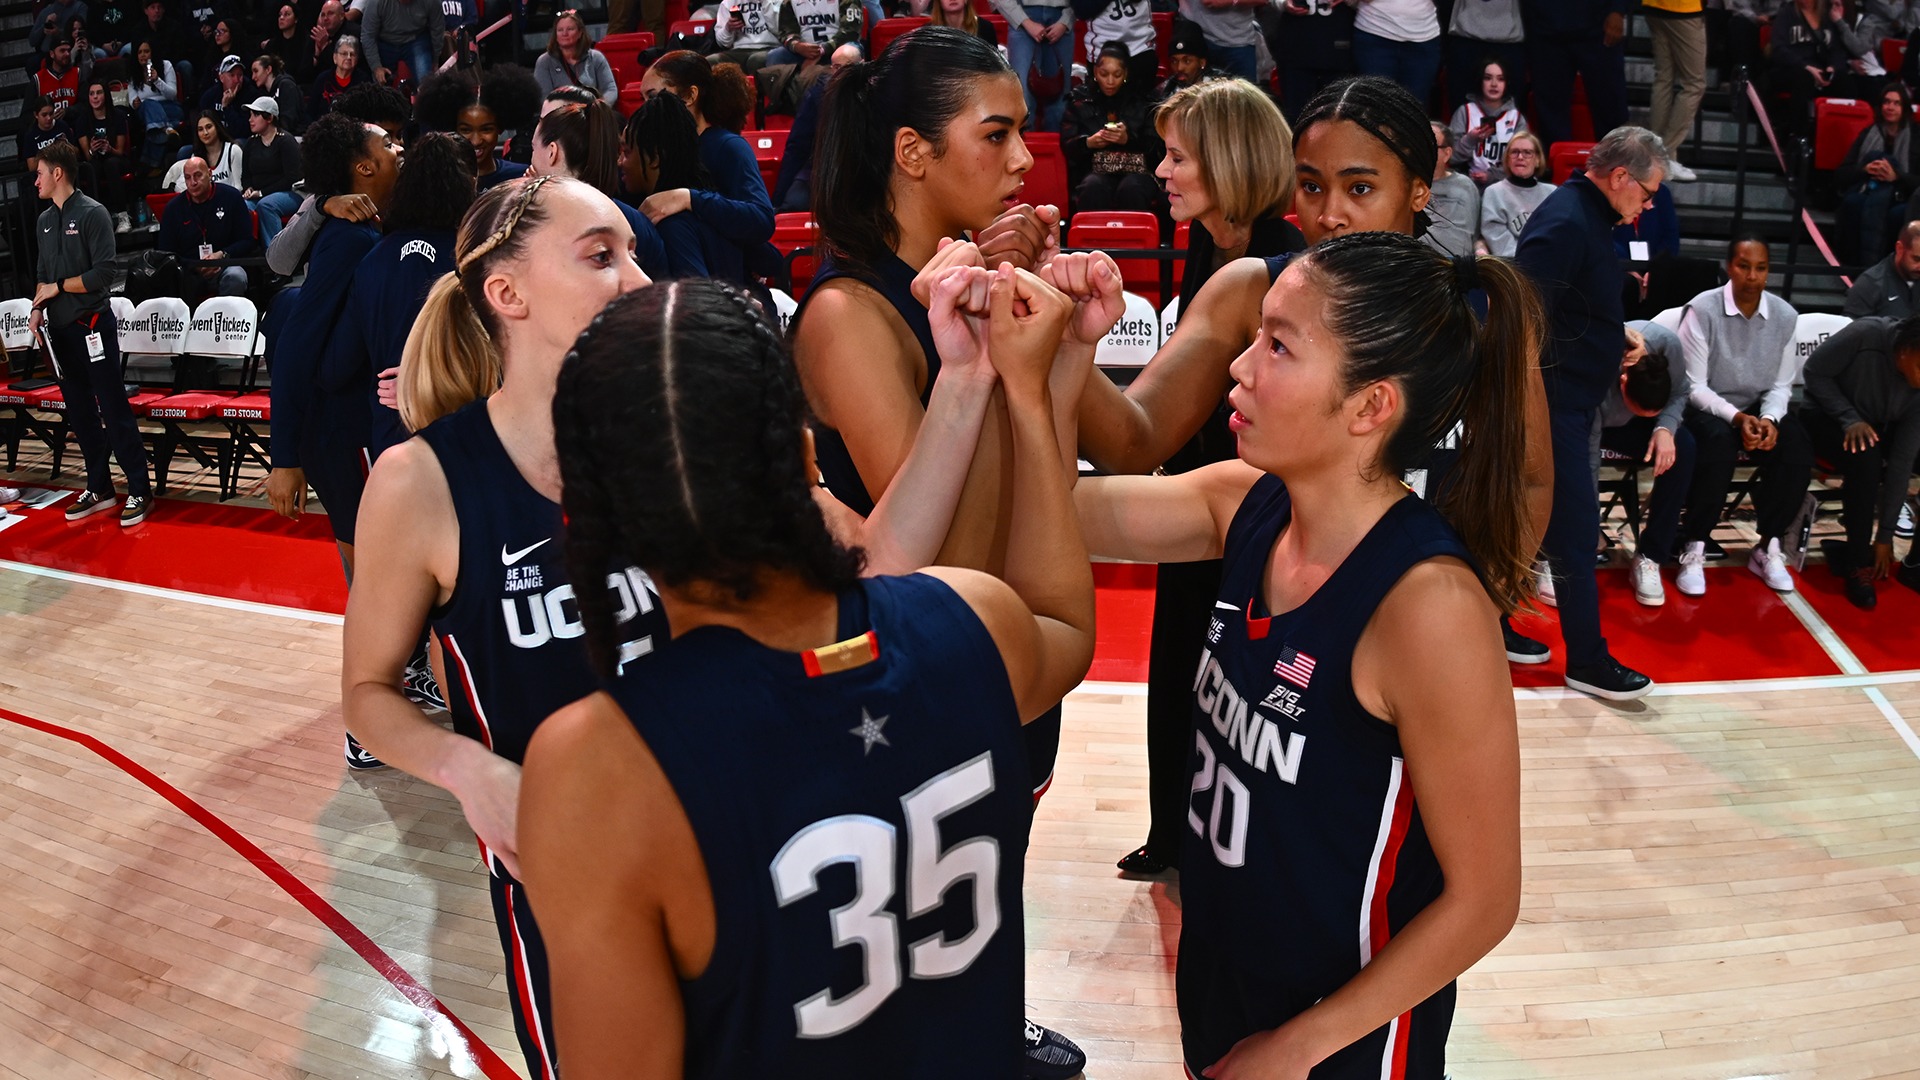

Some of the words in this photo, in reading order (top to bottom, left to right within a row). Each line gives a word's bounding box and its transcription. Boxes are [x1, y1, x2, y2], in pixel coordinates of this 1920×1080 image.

[442, 1, 463, 17] ONN
[800, 14, 836, 26] UCONN
[211, 171, 229, 182] ONN
[400, 239, 437, 263] HUSKIES
[130, 318, 150, 331] vent
[159, 317, 184, 332] tickets
[223, 317, 251, 333] tickets
[1110, 317, 1153, 337] ckets
[226, 333, 247, 341] center
[1107, 337, 1151, 346] center
[152, 408, 164, 417] RED
[164, 409, 187, 418] STORM
[223, 408, 237, 417] RED
[238, 409, 263, 419] STORM
[507, 569, 519, 581] BE
[522, 565, 540, 578] THE
[505, 576, 543, 592] CHANGE
[1271, 684, 1302, 704] BIG
[1264, 693, 1306, 717] EAST
[1188, 728, 1251, 868] 20
[768, 749, 1001, 1040] 35
